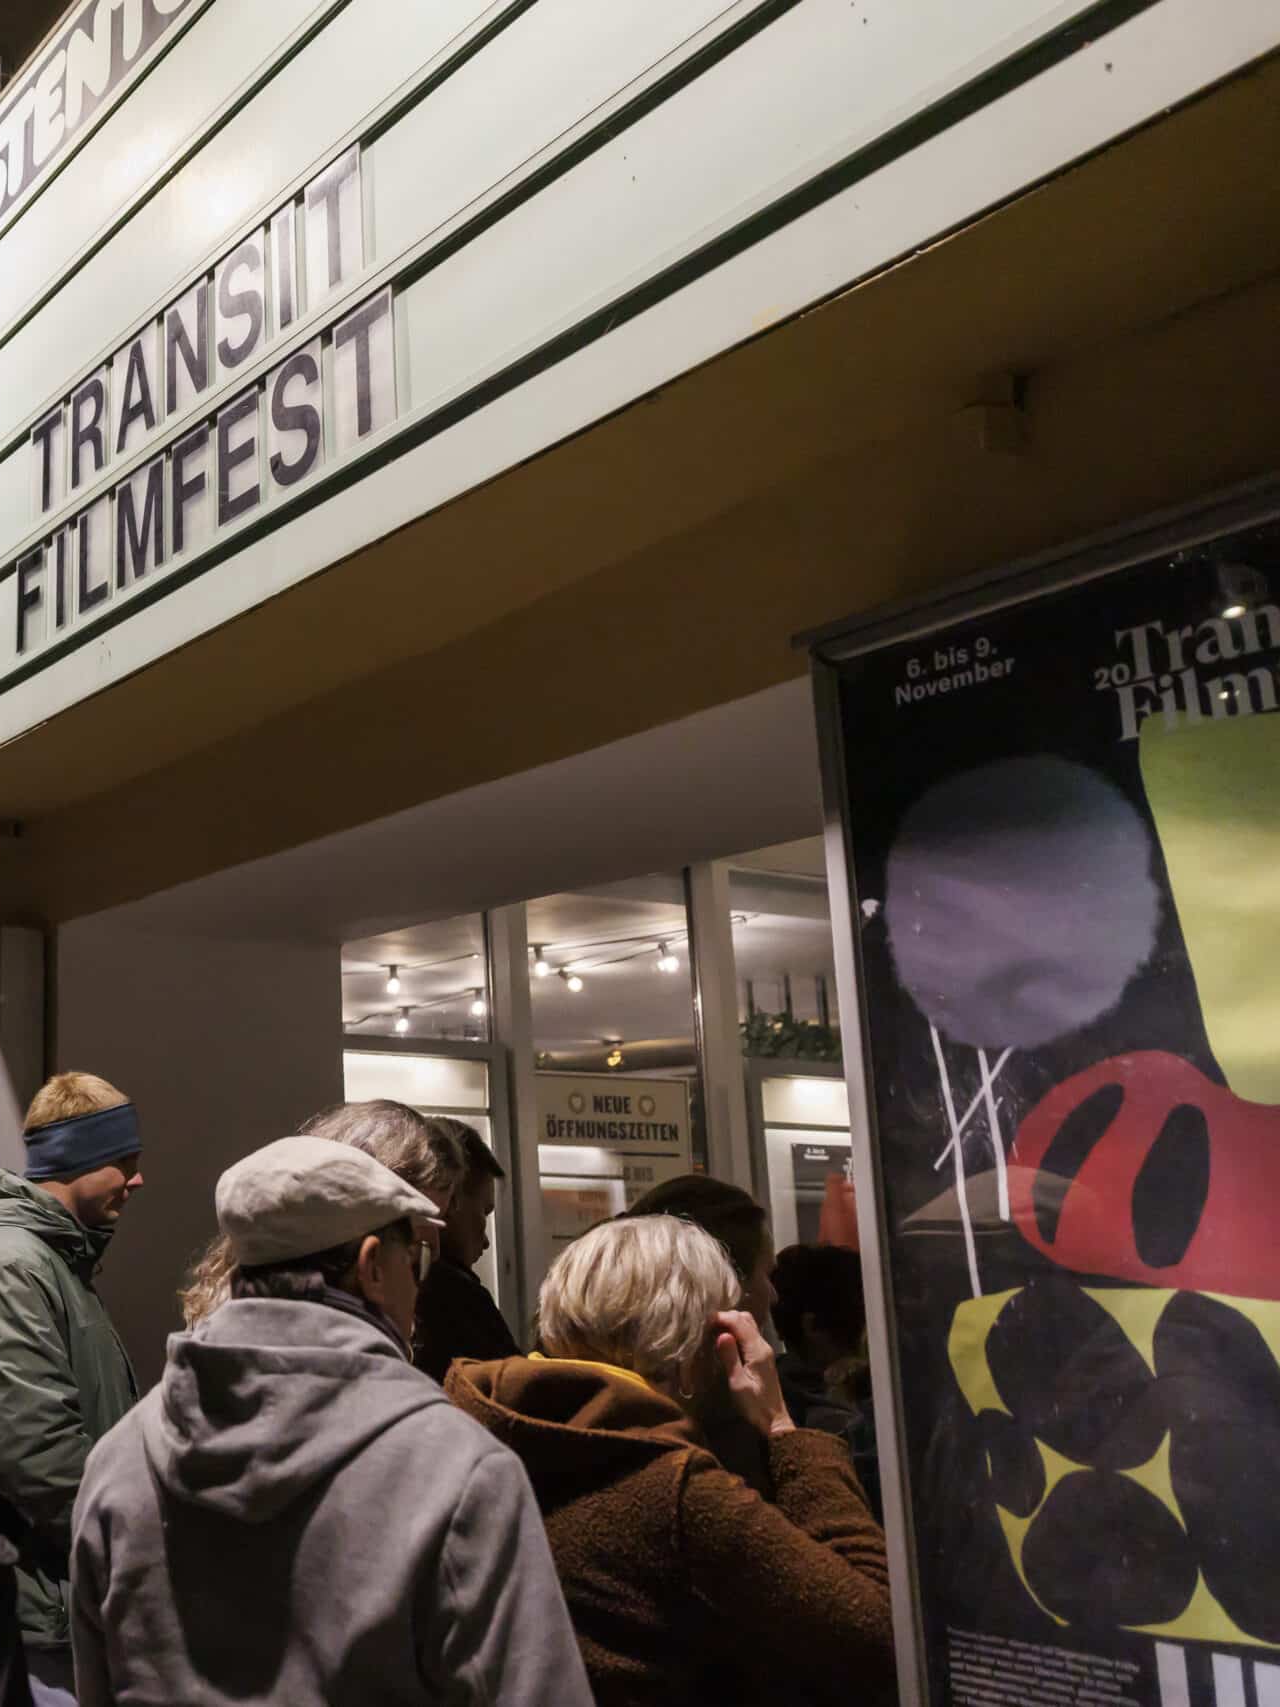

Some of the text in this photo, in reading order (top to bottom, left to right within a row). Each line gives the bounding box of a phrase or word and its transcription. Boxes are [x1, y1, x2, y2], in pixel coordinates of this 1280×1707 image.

[31, 152, 359, 513] TRANSIT
[16, 302, 391, 653] FILMFEST
[906, 636, 998, 679] 6. bis 9.
[894, 657, 1016, 706] November
[546, 1113, 679, 1142] ÖFFNUNGSZEITEN
[593, 1095, 632, 1115] NEUE
